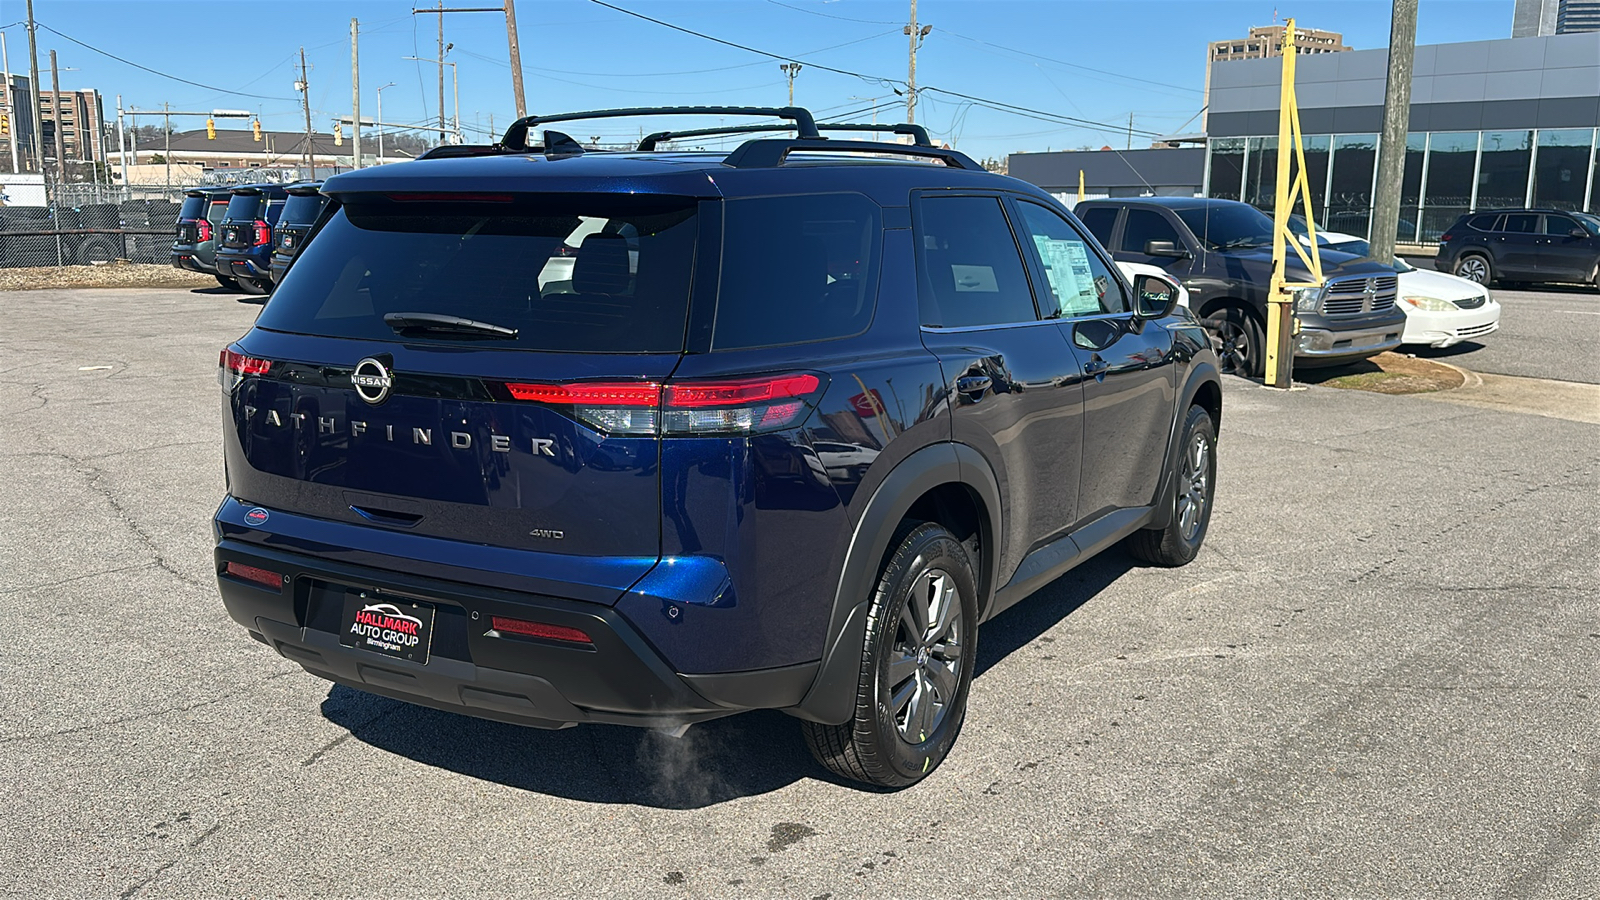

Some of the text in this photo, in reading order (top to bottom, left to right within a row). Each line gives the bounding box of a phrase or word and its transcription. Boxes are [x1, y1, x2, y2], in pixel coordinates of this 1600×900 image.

[351, 374, 391, 387] NISSAN
[244, 405, 555, 457] PATHFINDER
[529, 529, 564, 539] 4WD
[356, 610, 418, 635] HALLMARK
[350, 622, 419, 647] AUTO GROUP
[366, 637, 401, 652] Birmingham
